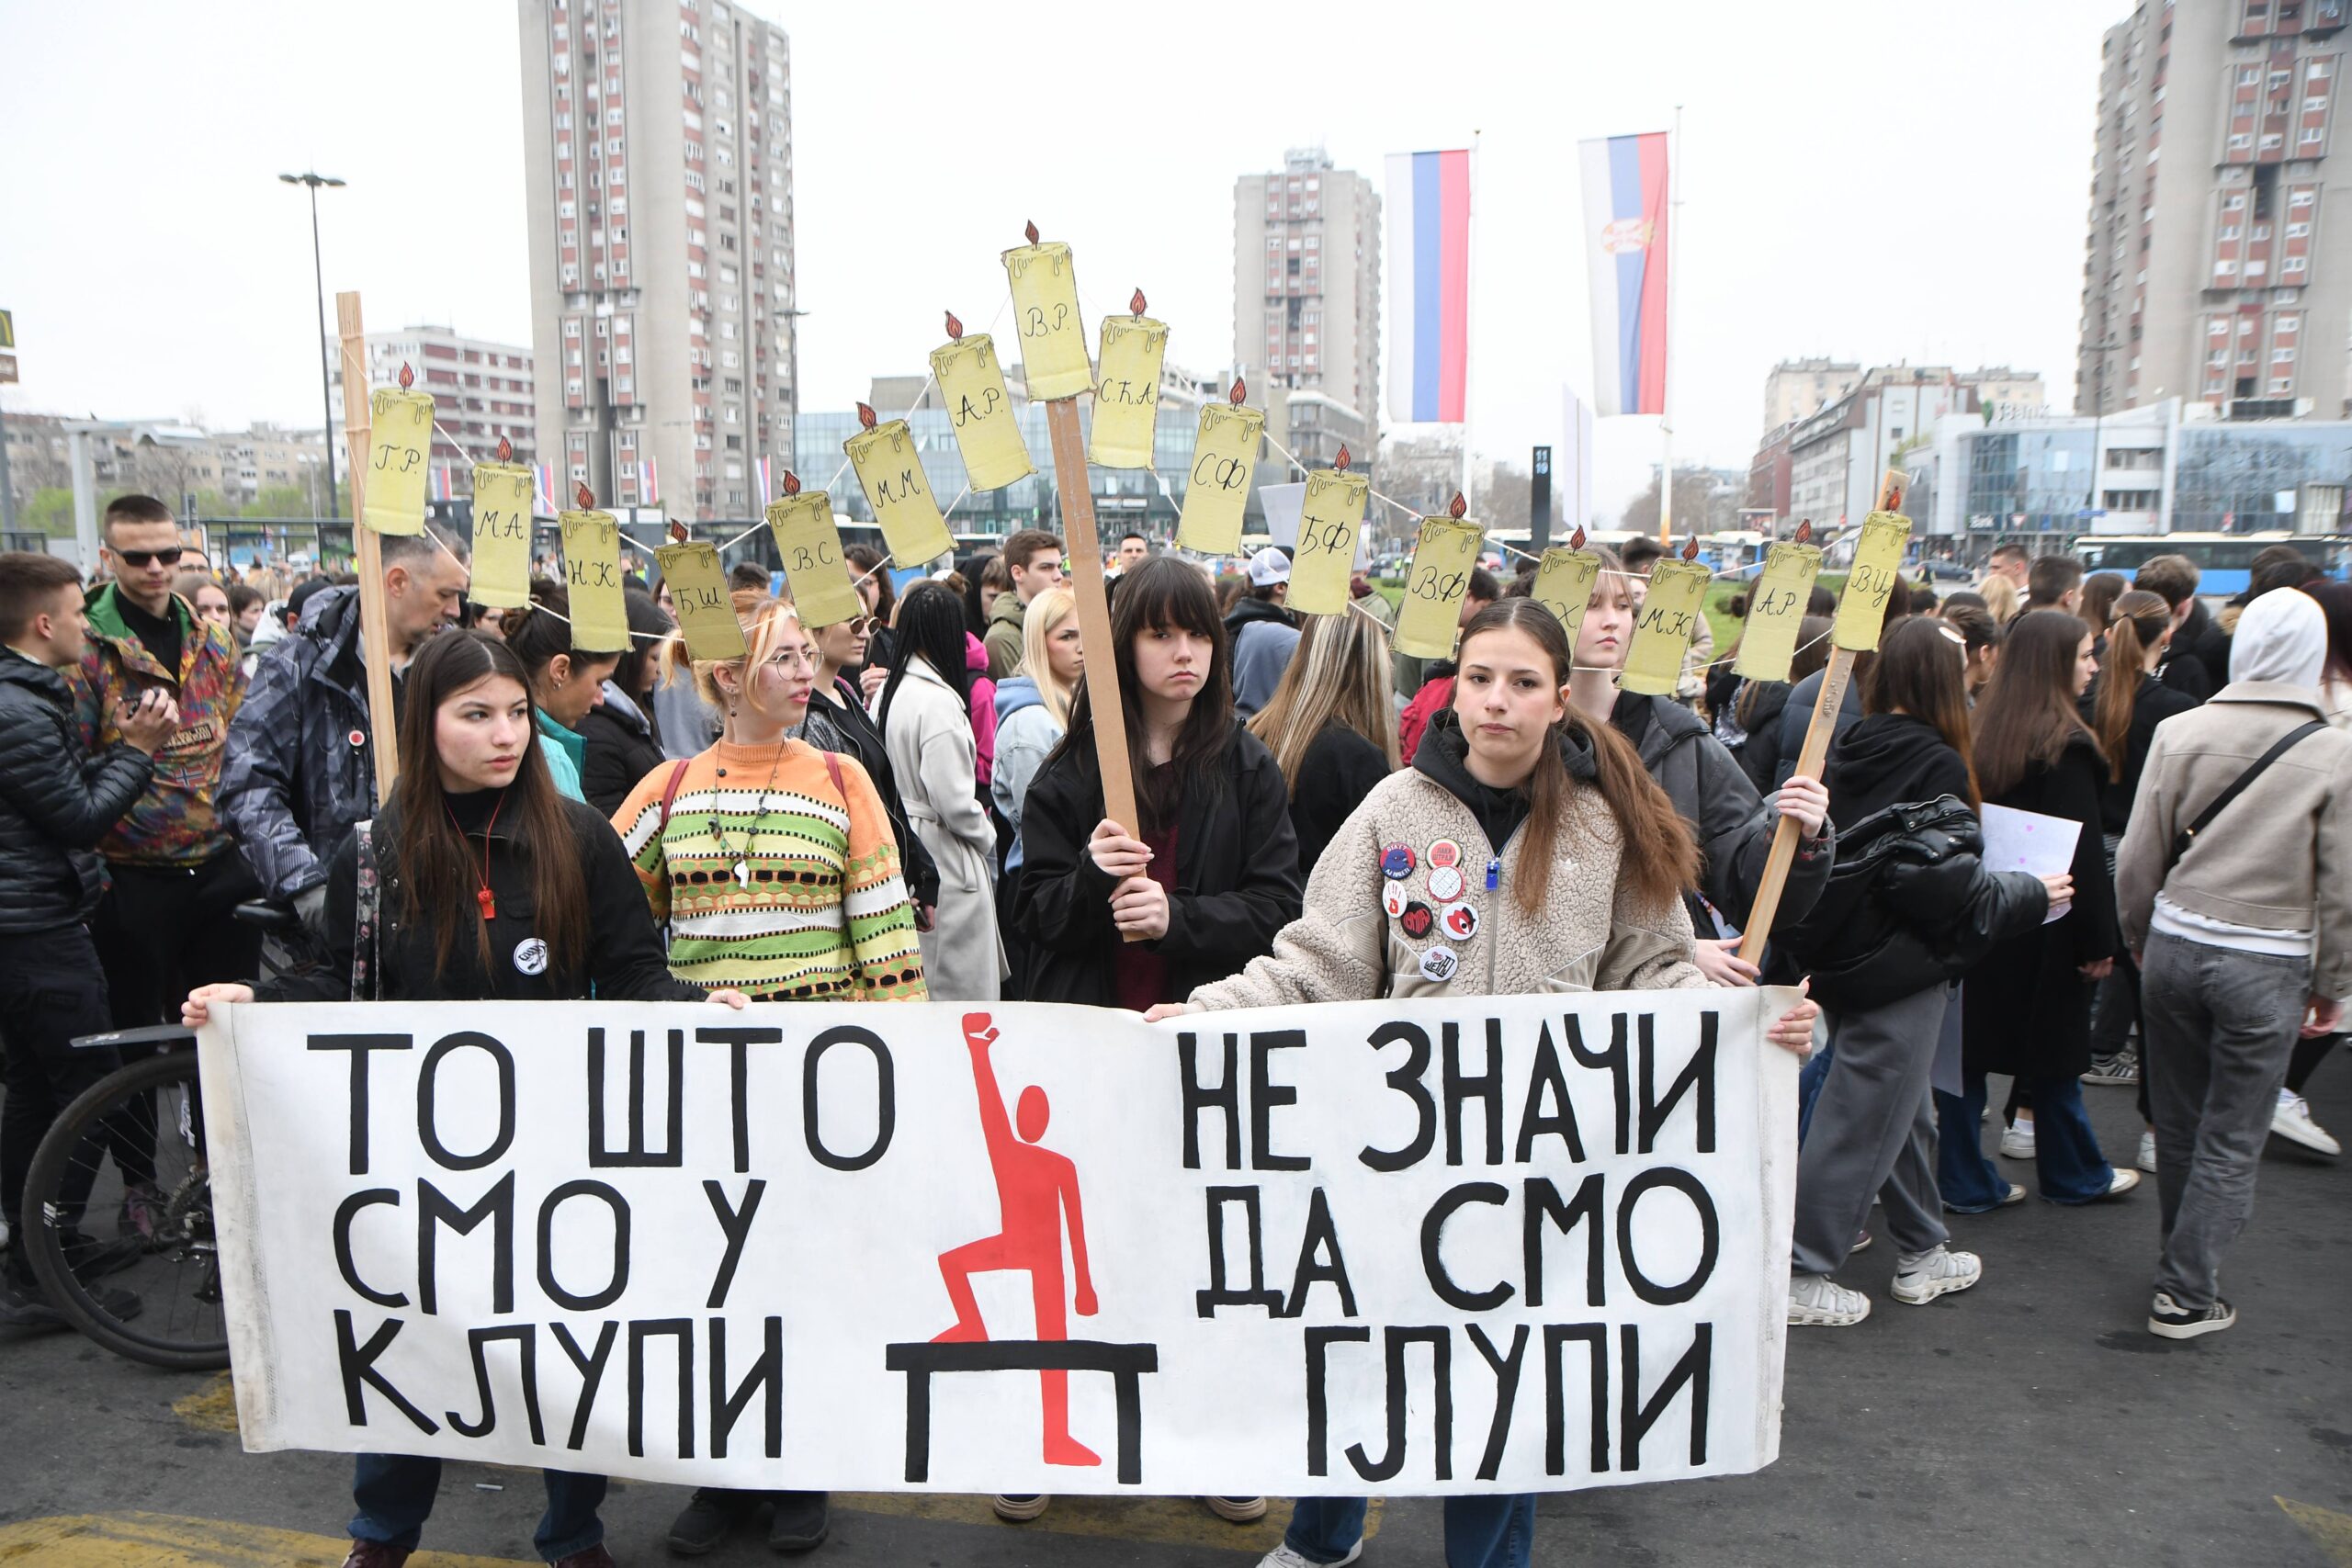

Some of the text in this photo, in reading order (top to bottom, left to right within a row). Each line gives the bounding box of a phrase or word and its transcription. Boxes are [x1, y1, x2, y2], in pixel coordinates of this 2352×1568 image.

[307, 1025, 896, 1175] ТО ШТО
[1177, 1011, 1719, 1172] НЕ ЗНАЧИ
[333, 1170, 767, 1315] СМО У
[1196, 1167, 1719, 1318] ДА СМО
[334, 1309, 782, 1459] КЛУПИ
[1305, 1322, 1713, 1482] ГЛУПИ
